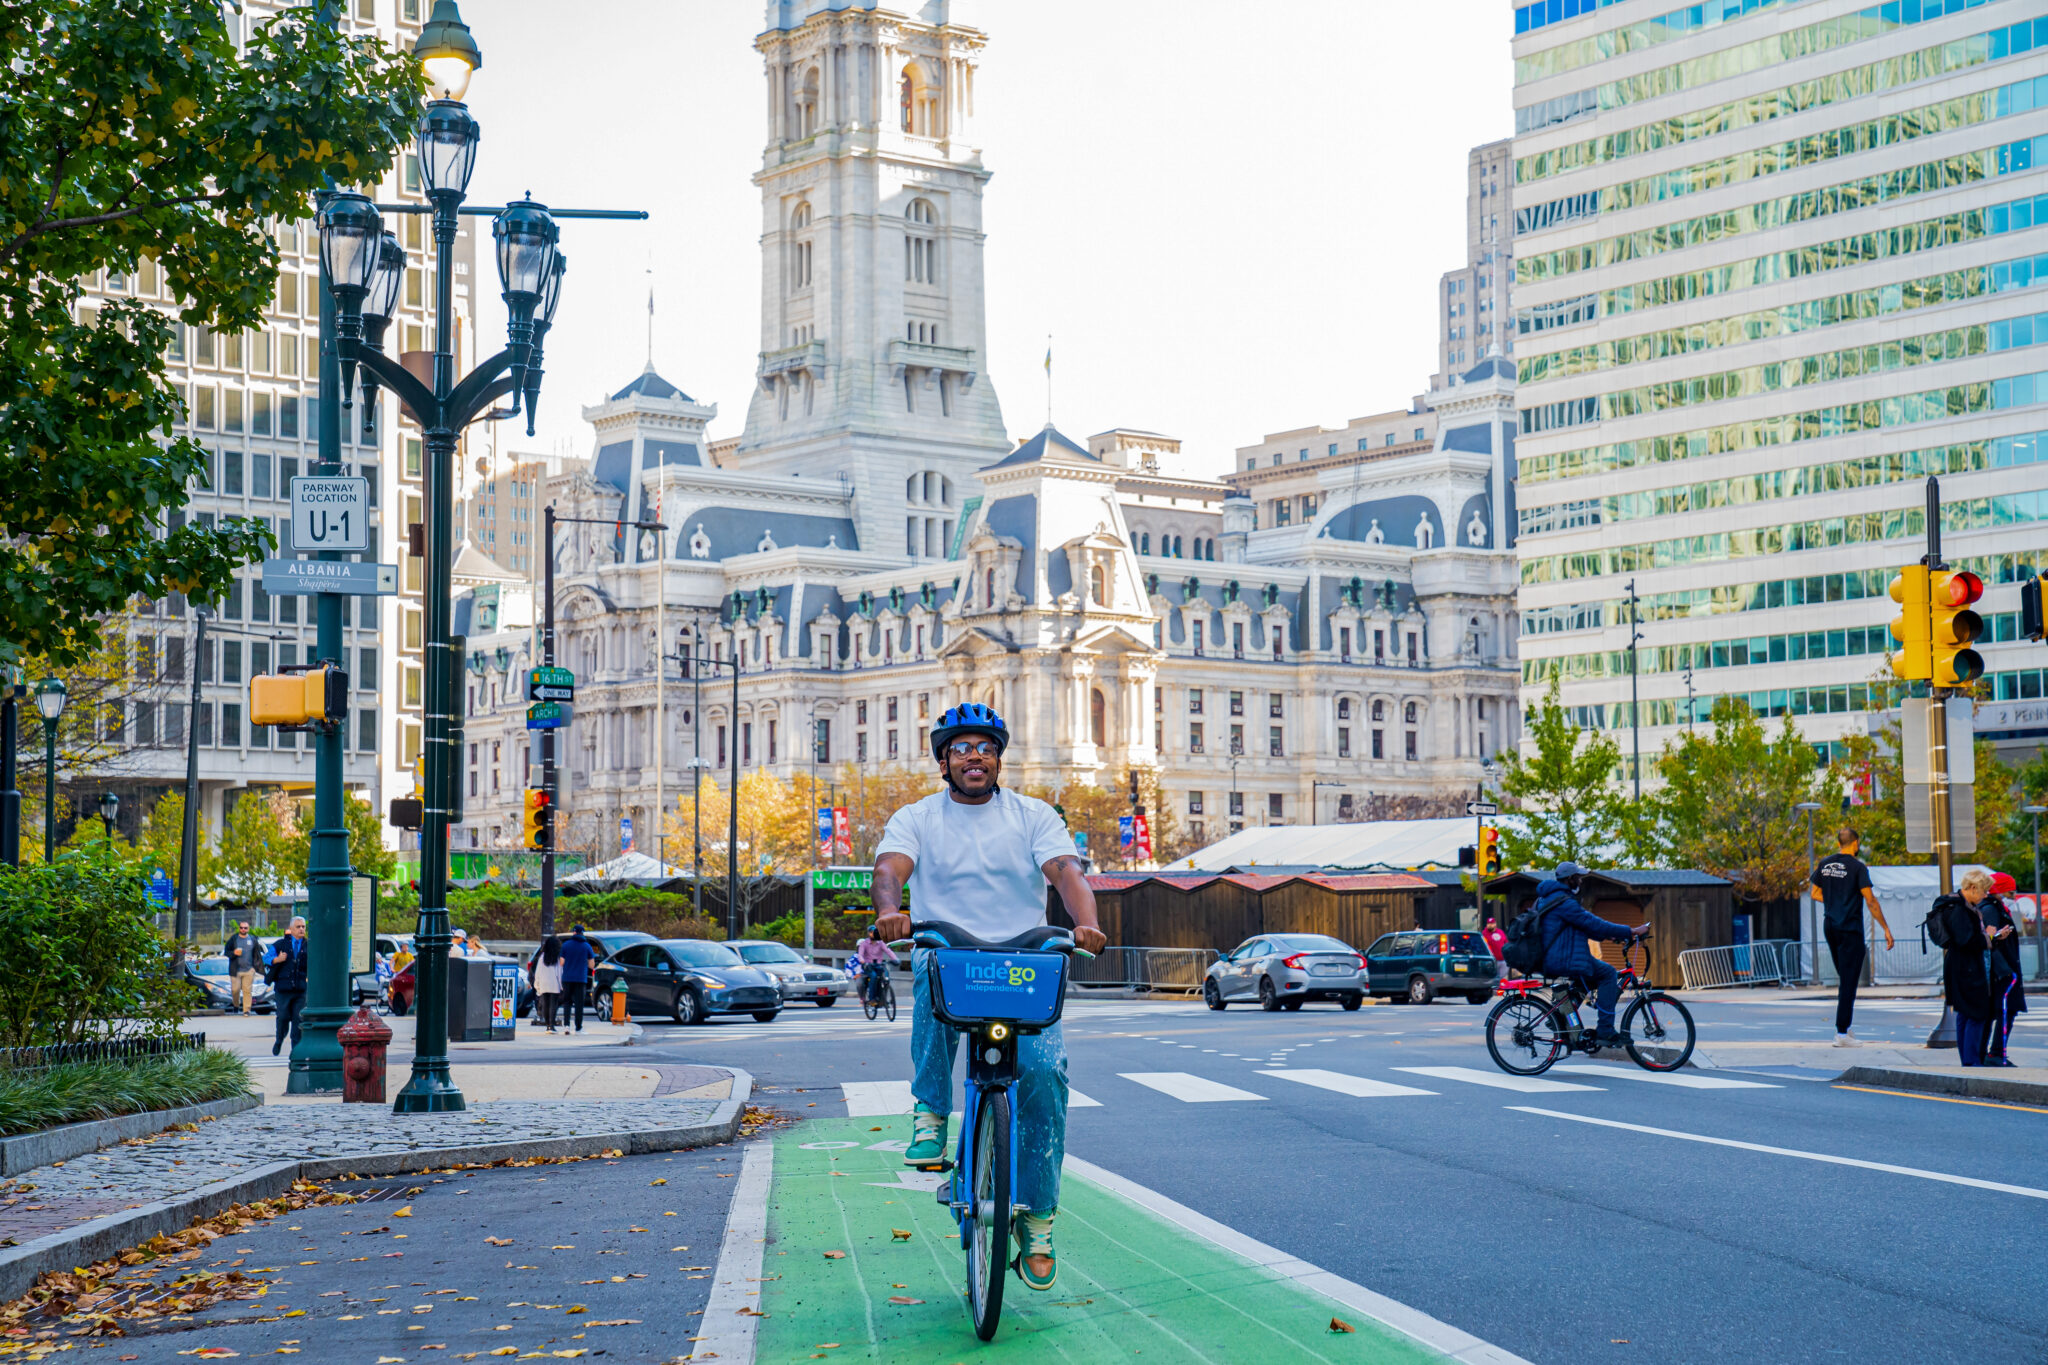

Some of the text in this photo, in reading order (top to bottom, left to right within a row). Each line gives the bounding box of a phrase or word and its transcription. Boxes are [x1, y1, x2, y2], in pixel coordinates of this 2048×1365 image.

[303, 484, 354, 492] PARKWAY
[301, 494, 357, 502] LOCATION
[309, 510, 350, 542] U-1
[288, 564, 351, 577] ALBANIA
[535, 708, 553, 719] ARCH
[2000, 711, 2007, 724] 2
[965, 962, 1036, 986] Indego
[965, 984, 1025, 992] Independence
